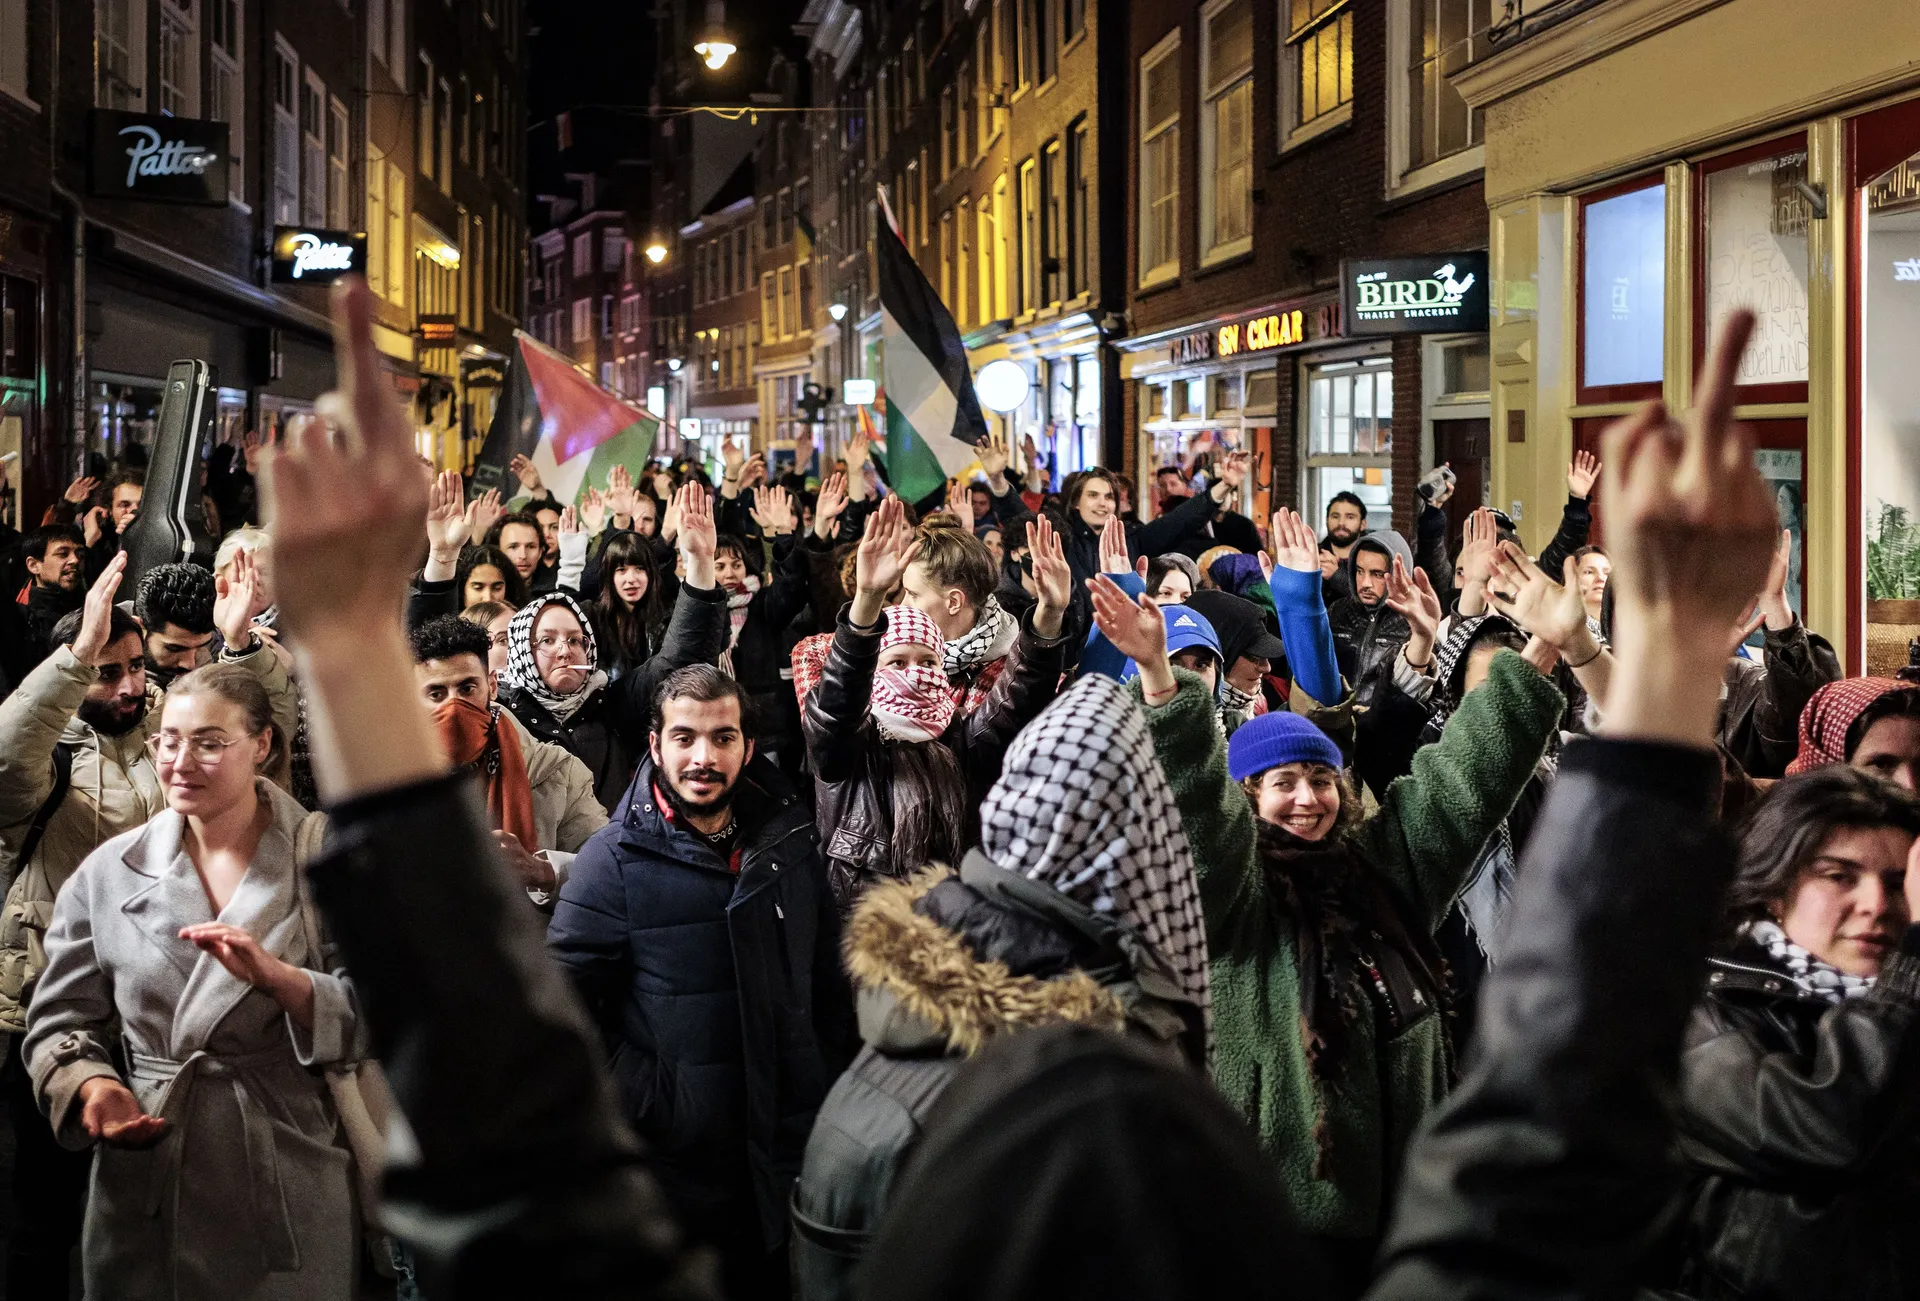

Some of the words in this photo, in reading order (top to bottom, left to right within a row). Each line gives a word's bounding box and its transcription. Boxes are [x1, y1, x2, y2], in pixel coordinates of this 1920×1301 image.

[118, 125, 206, 188] Patta
[288, 233, 354, 279] Patta
[1357, 279, 1445, 307] BIRD
[1358, 310, 1396, 321] THAISE
[1403, 307, 1459, 319] SNACKBAR
[1218, 309, 1304, 357] SNACKBAR
